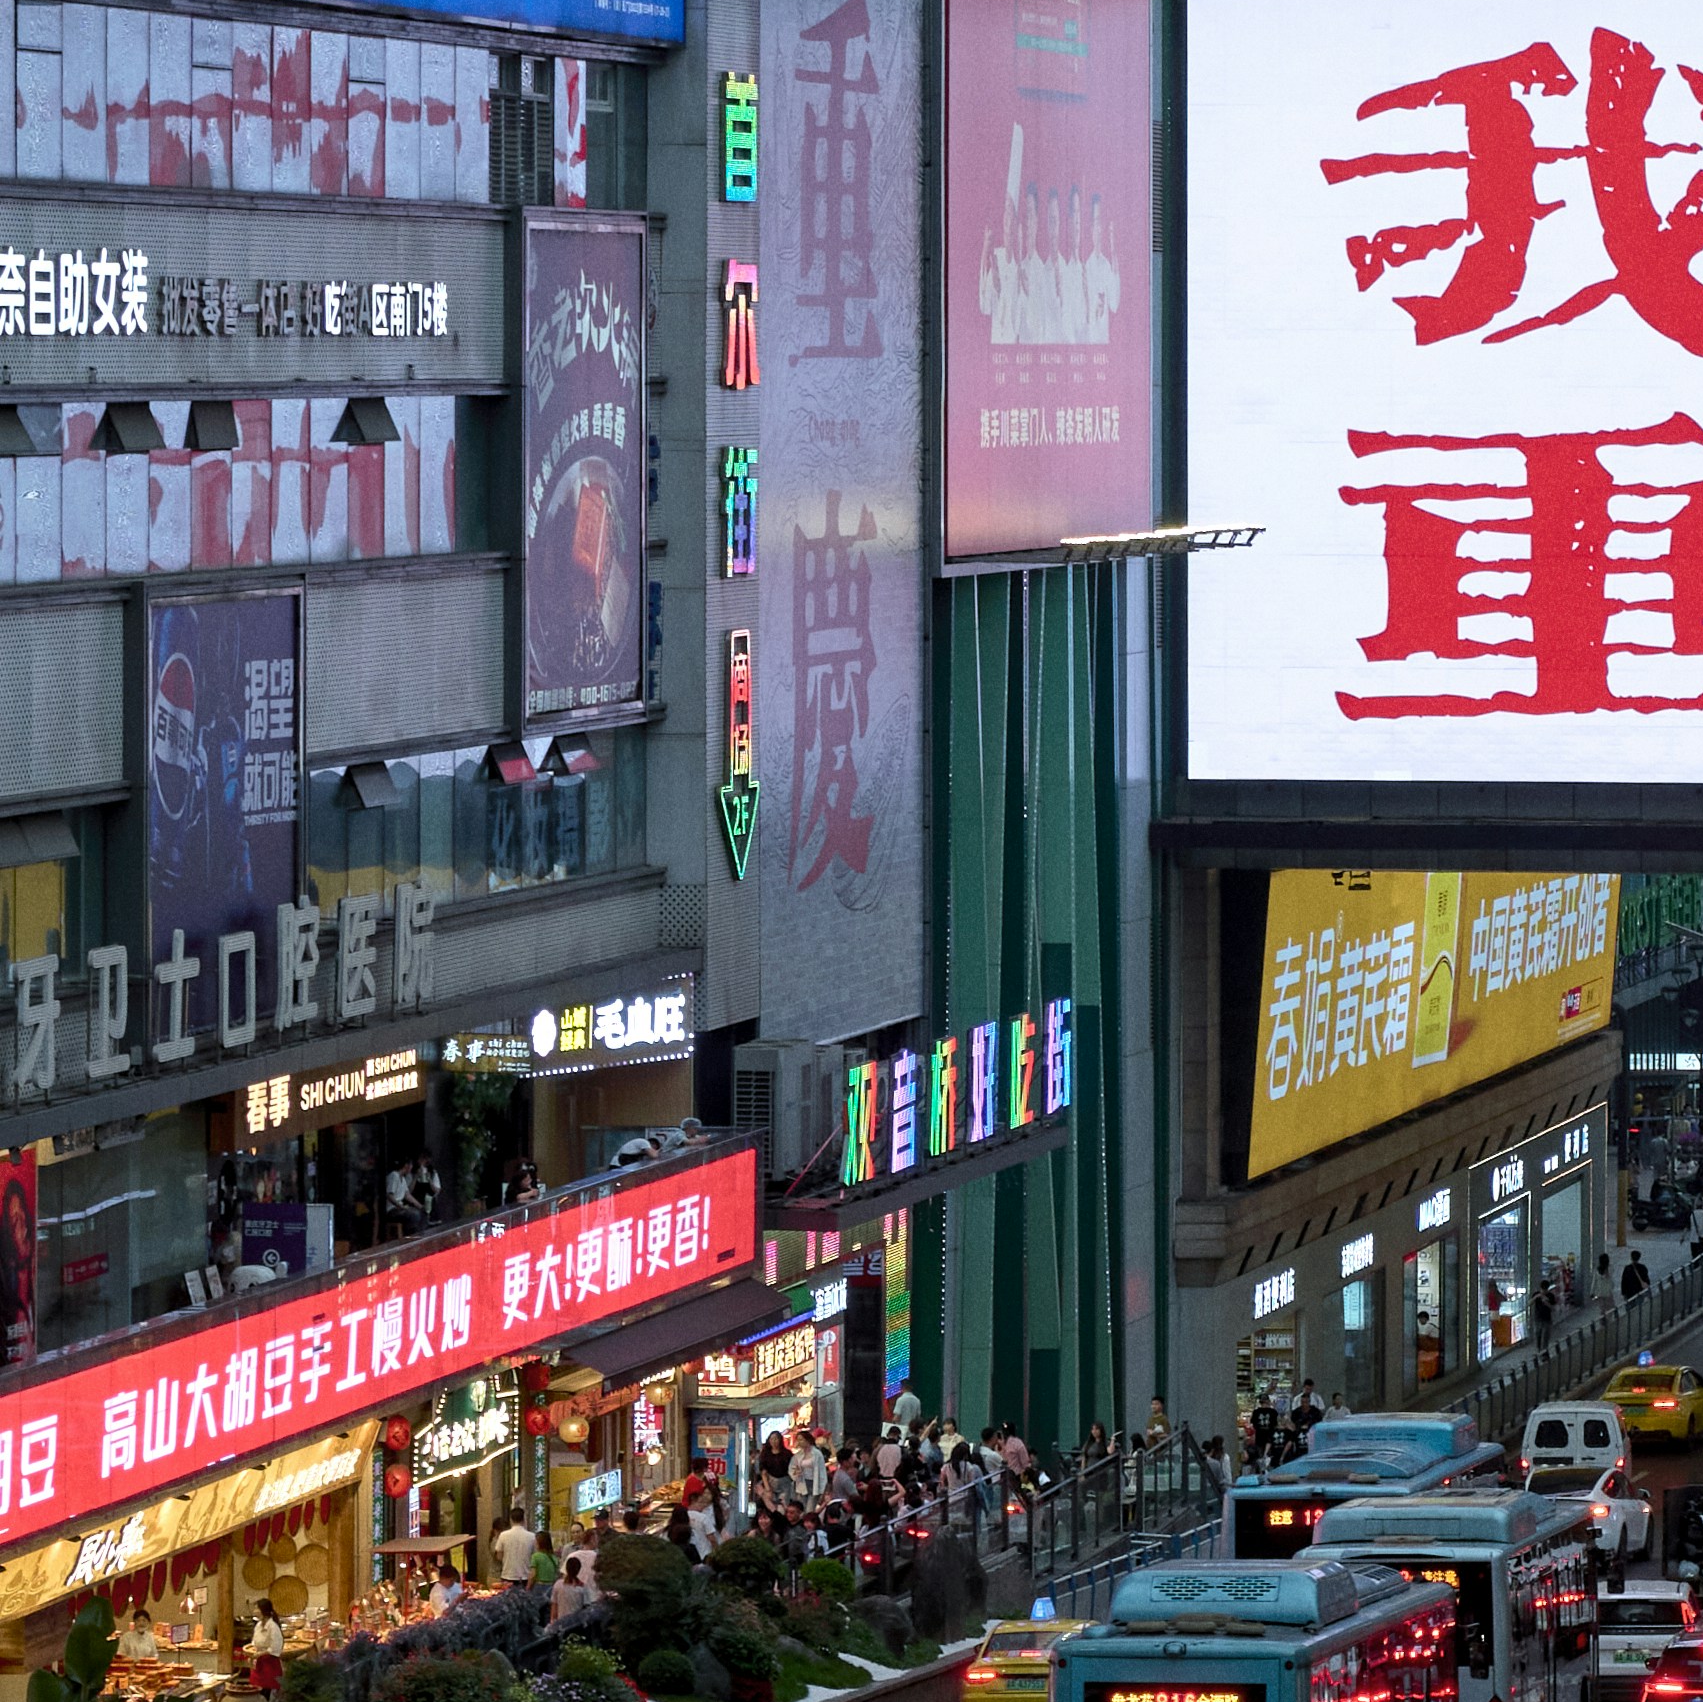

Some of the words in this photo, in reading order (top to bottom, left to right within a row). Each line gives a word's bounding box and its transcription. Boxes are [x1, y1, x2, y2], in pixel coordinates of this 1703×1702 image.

[0, 246, 148, 337] 奈自助女装
[161, 276, 298, 335] 批发零售一体店
[303, 279, 449, 337] 好吃街A区南门5楼
[980, 405, 1120, 448] 携手川菜掌门人、辣条发明人研发
[245, 658, 294, 742] 渴望
[732, 652, 750, 776] 商场
[242, 750, 296, 811] 就可能
[731, 796, 750, 838] 2F
[12, 879, 436, 1090] 牙卫士口腔医院
[1265, 921, 1415, 1101] 春娟黄芪霜
[1469, 874, 1612, 1002] 中国黄芪霜开创者
[300, 1080, 324, 1111] SHI
[325, 1069, 365, 1104] CHUN
[375, 1055, 390, 1075] SHI
[390, 1048, 416, 1071] CHUN
[247, 1075, 290, 1134] 春事
[101, 1272, 472, 1479] 高山大胡豆手工慢火炒
